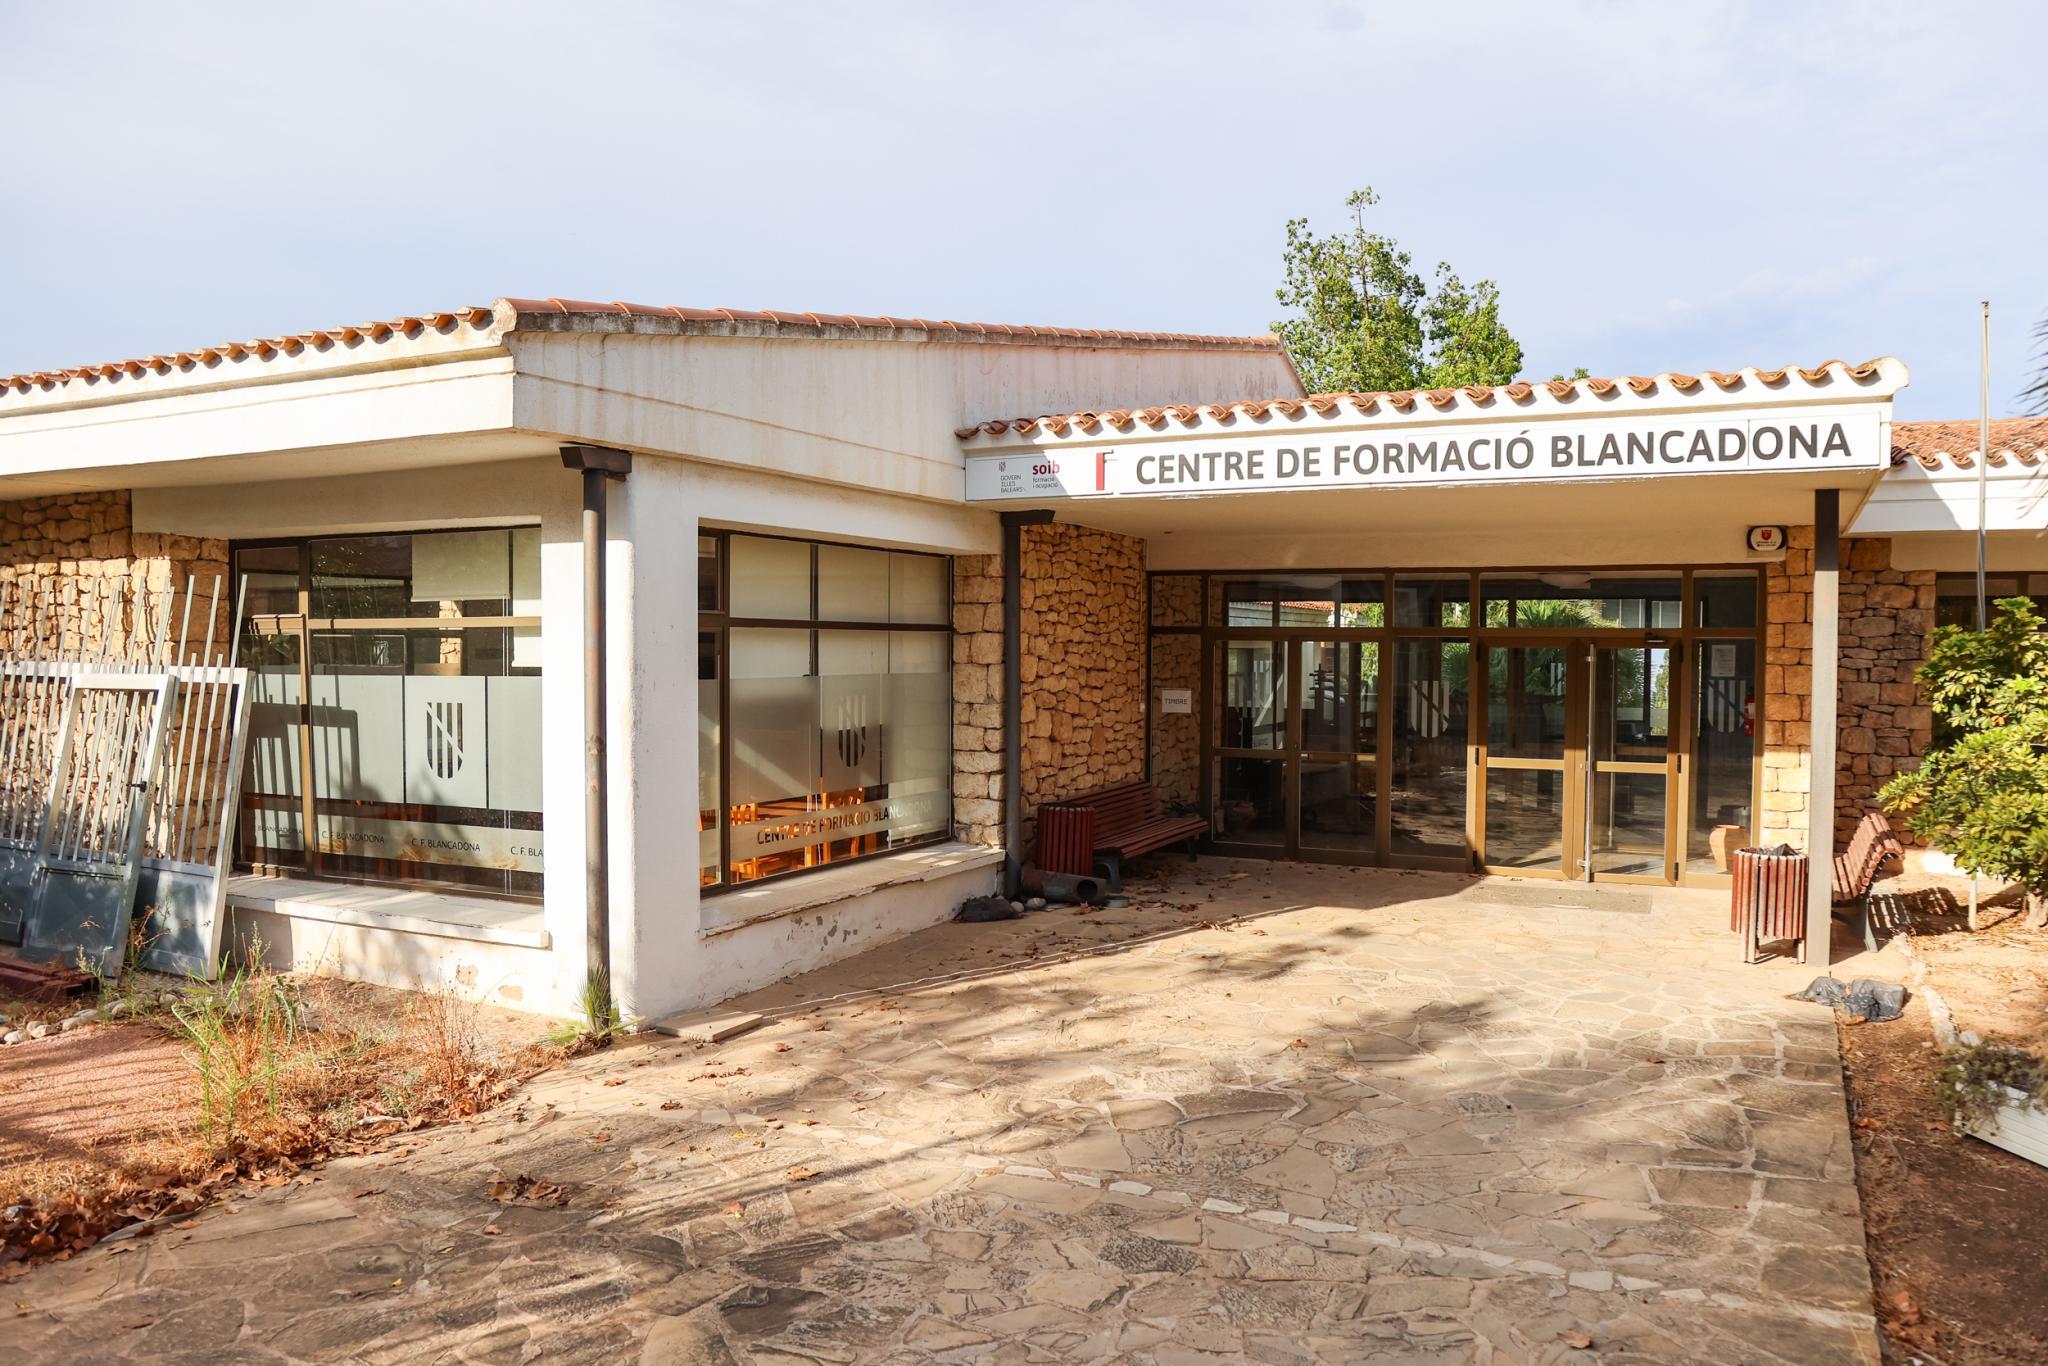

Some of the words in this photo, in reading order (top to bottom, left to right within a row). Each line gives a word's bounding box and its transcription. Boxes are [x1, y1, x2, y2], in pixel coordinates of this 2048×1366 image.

[1136, 449, 1264, 485] CENTRE
[1276, 446, 1321, 479] DE
[1333, 430, 1535, 477] FORMACIÓ
[1550, 423, 1852, 468] BLANCADONA
[1032, 461, 1060, 475] soib
[427, 839, 481, 852] BLANCADONA
[510, 846, 518, 855] C.
